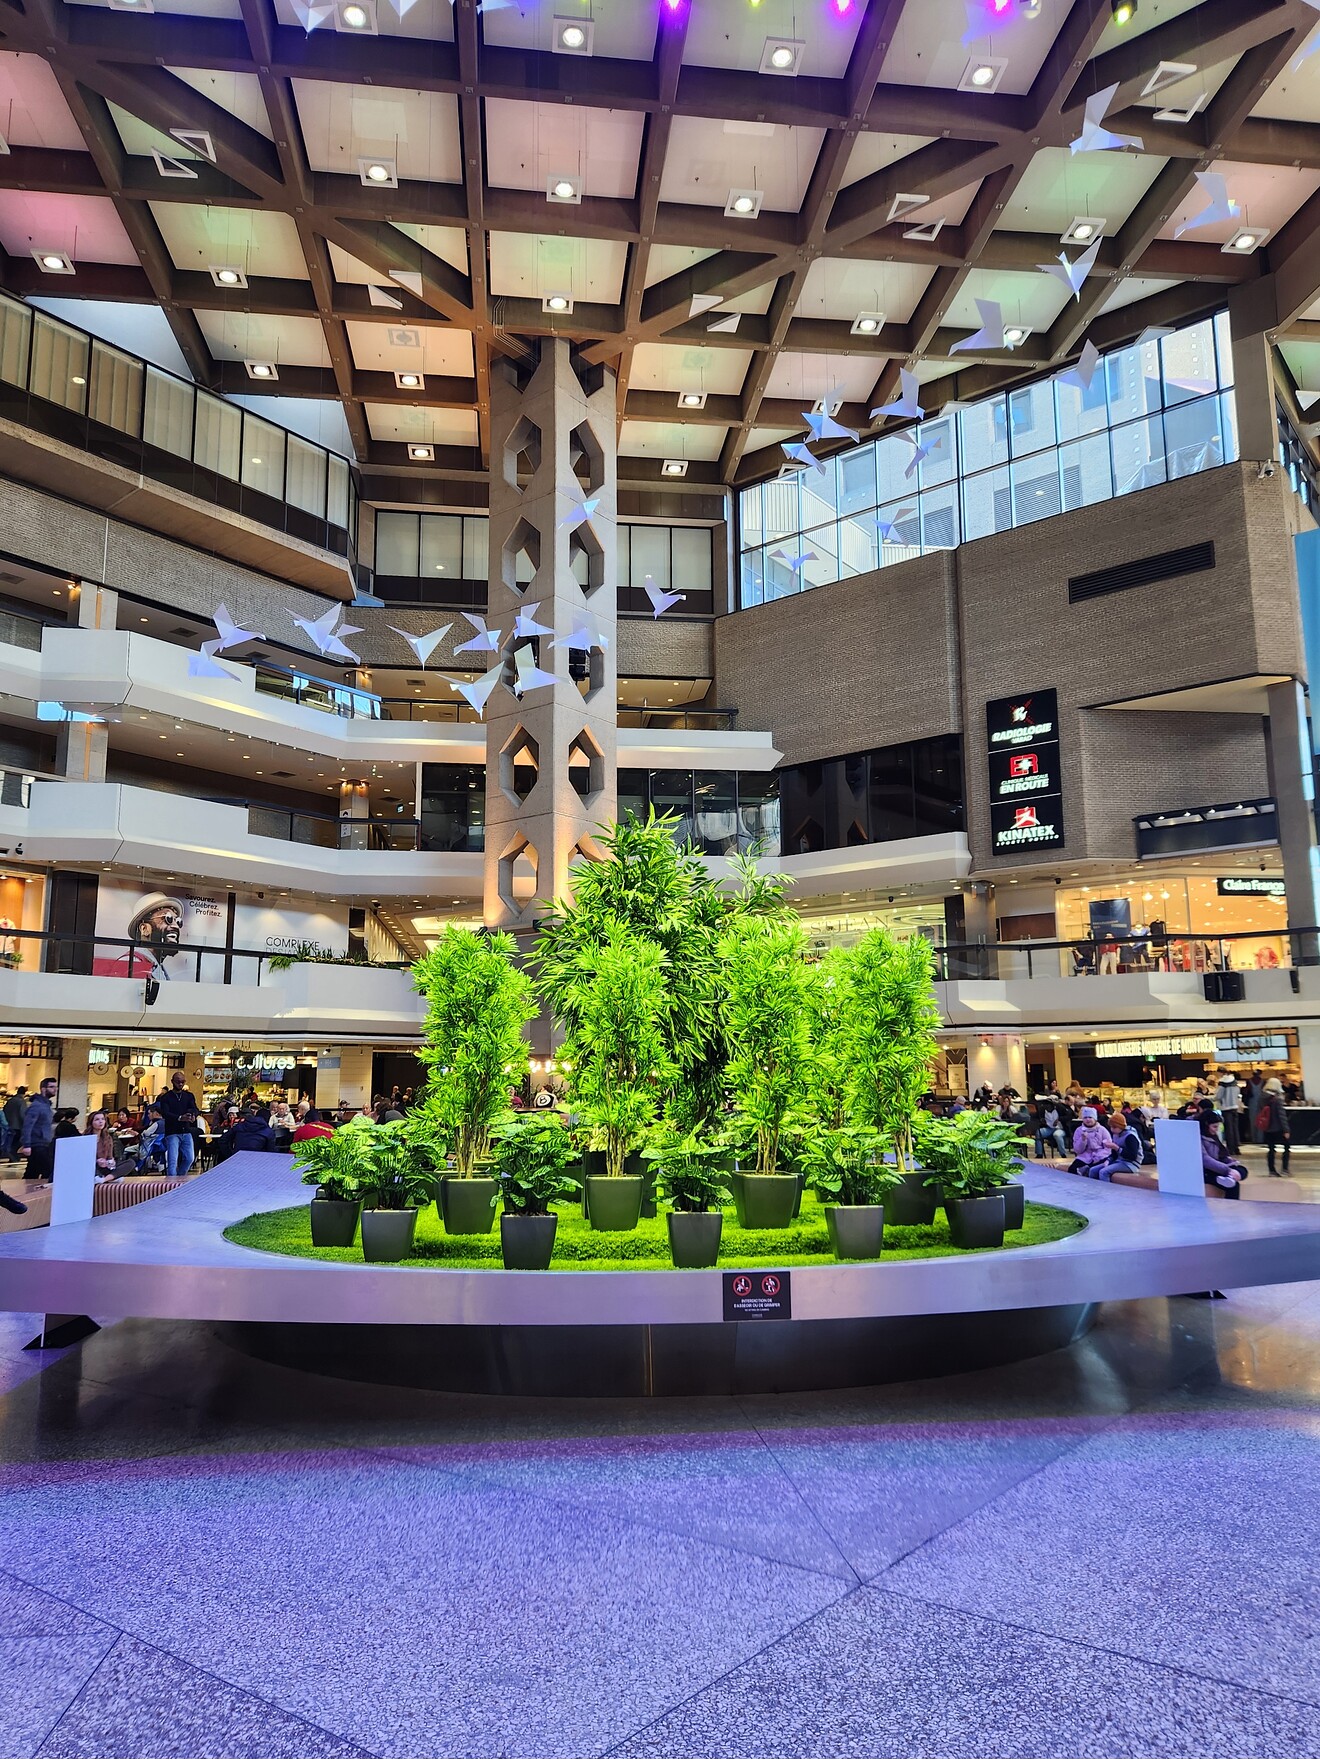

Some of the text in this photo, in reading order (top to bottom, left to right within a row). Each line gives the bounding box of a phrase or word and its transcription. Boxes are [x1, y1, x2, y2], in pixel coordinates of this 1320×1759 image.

[991, 722, 1052, 742] RADIOLOGIE
[999, 778, 1050, 795] EN ROUTE
[997, 824, 1055, 842] KINATEX
[185, 893, 216, 903] Savourez.
[189, 900, 219, 910] Célébrez.
[195, 908, 222, 917] Profitez.
[266, 936, 320, 950] COMPLEXE
[236, 1053, 296, 1070] cultures
